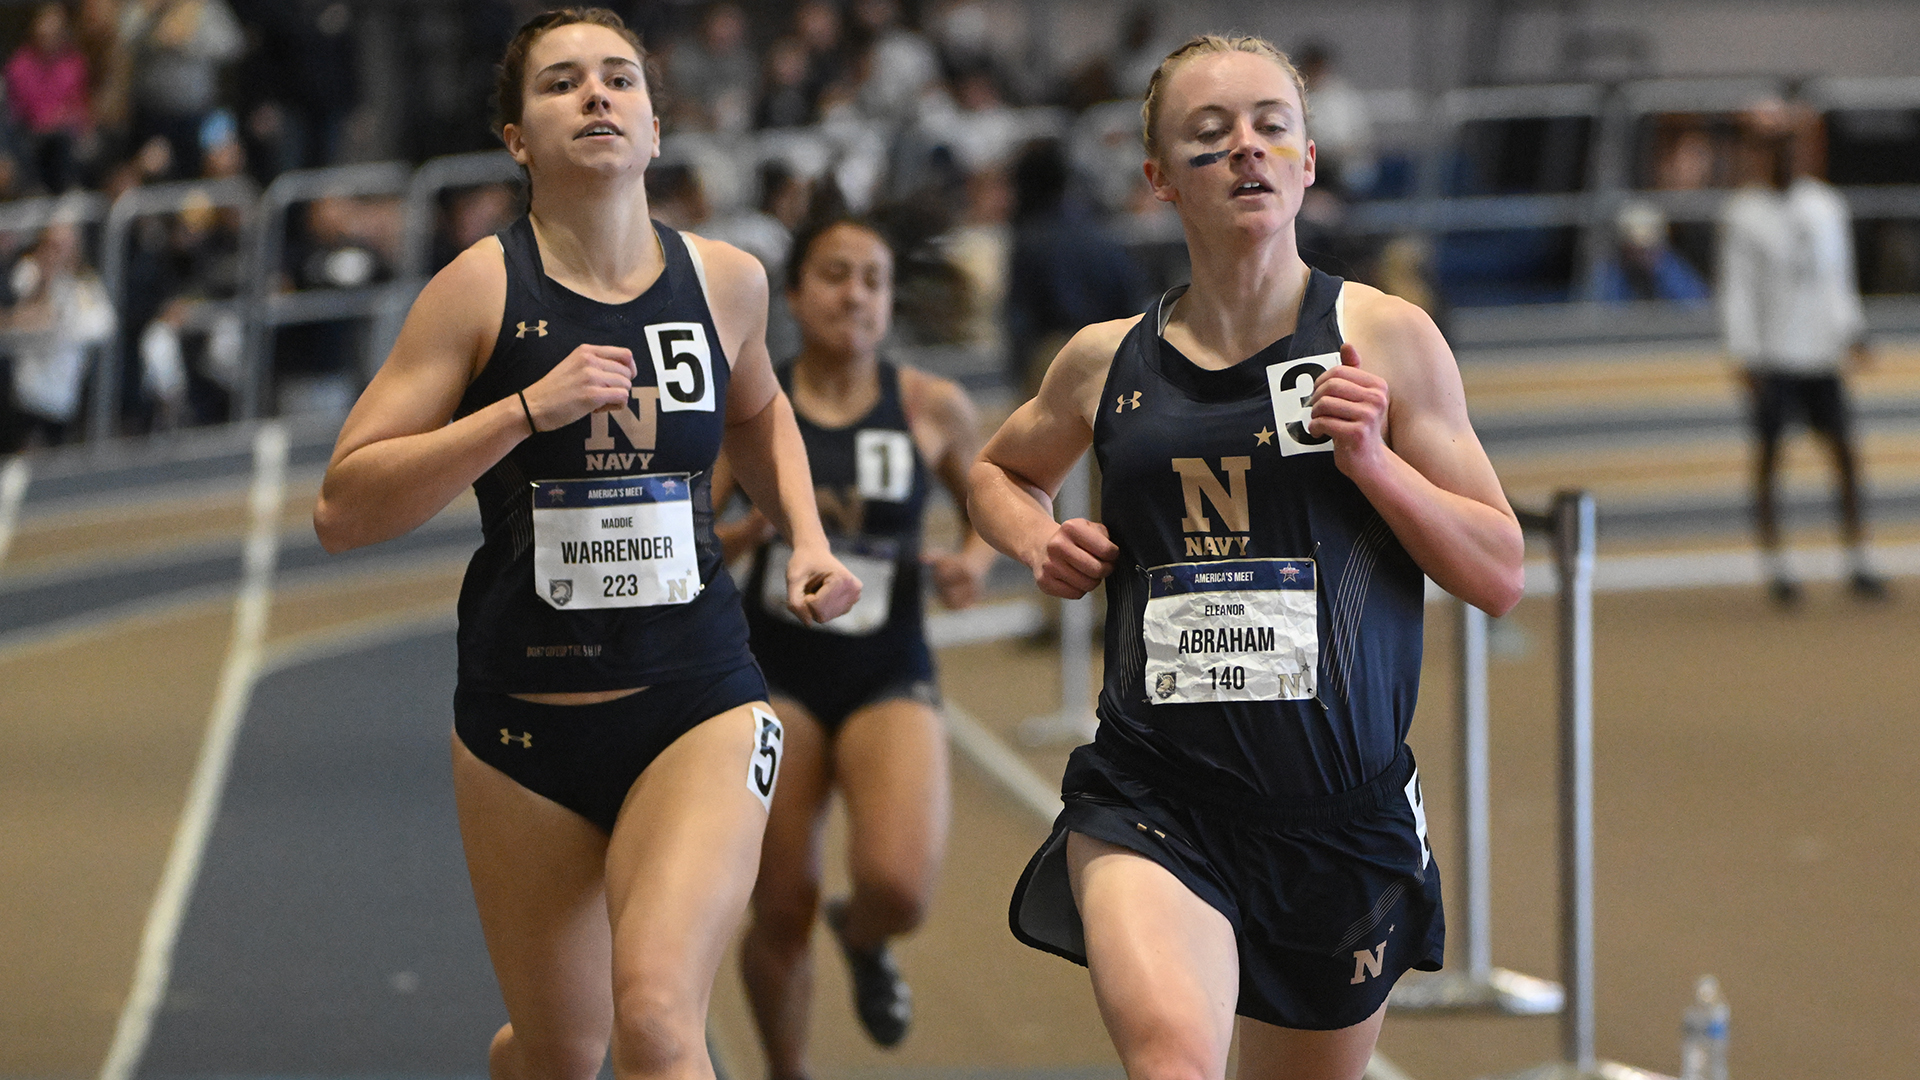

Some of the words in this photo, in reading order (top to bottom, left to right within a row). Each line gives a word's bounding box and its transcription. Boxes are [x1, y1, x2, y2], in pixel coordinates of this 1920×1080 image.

[658, 329, 705, 403] 5
[1280, 362, 1336, 446] 3
[584, 386, 660, 451] N
[585, 453, 654, 471] NAVY
[871, 443, 889, 488] 1
[588, 488, 625, 499] AMERICA'S
[625, 486, 643, 497] MEET
[1171, 456, 1252, 533] N
[601, 517, 634, 530] MADDIE
[561, 536, 674, 564] WARRENDER
[1183, 536, 1251, 557] NAVY
[603, 574, 638, 597] 223
[666, 578, 689, 602] N
[1194, 572, 1233, 584] AMERICA'S
[1234, 571, 1254, 582] MEET
[1204, 604, 1245, 617] ELEANOR
[1178, 627, 1275, 654] ABRAHAM
[1208, 666, 1245, 690] 140
[1277, 673, 1302, 698] N
[754, 716, 782, 798] 5
[1350, 940, 1388, 985] N
